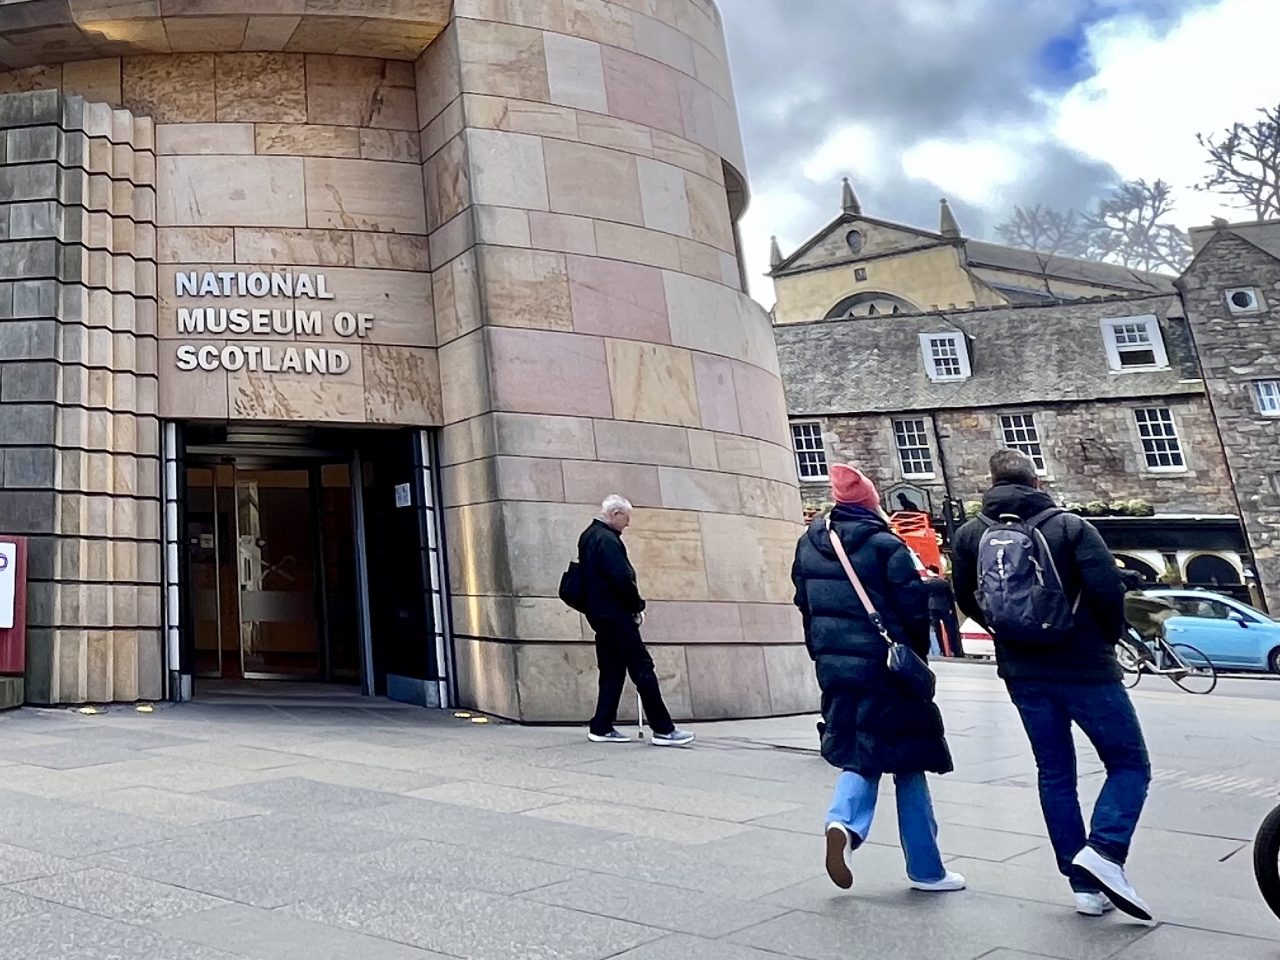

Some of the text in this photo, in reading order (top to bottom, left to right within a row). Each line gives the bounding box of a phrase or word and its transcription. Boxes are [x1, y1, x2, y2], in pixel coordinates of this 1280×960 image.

[175, 271, 334, 299] NATIONAL
[176, 307, 375, 337] MUSEUM OF
[176, 345, 351, 375] SCOTLAND
